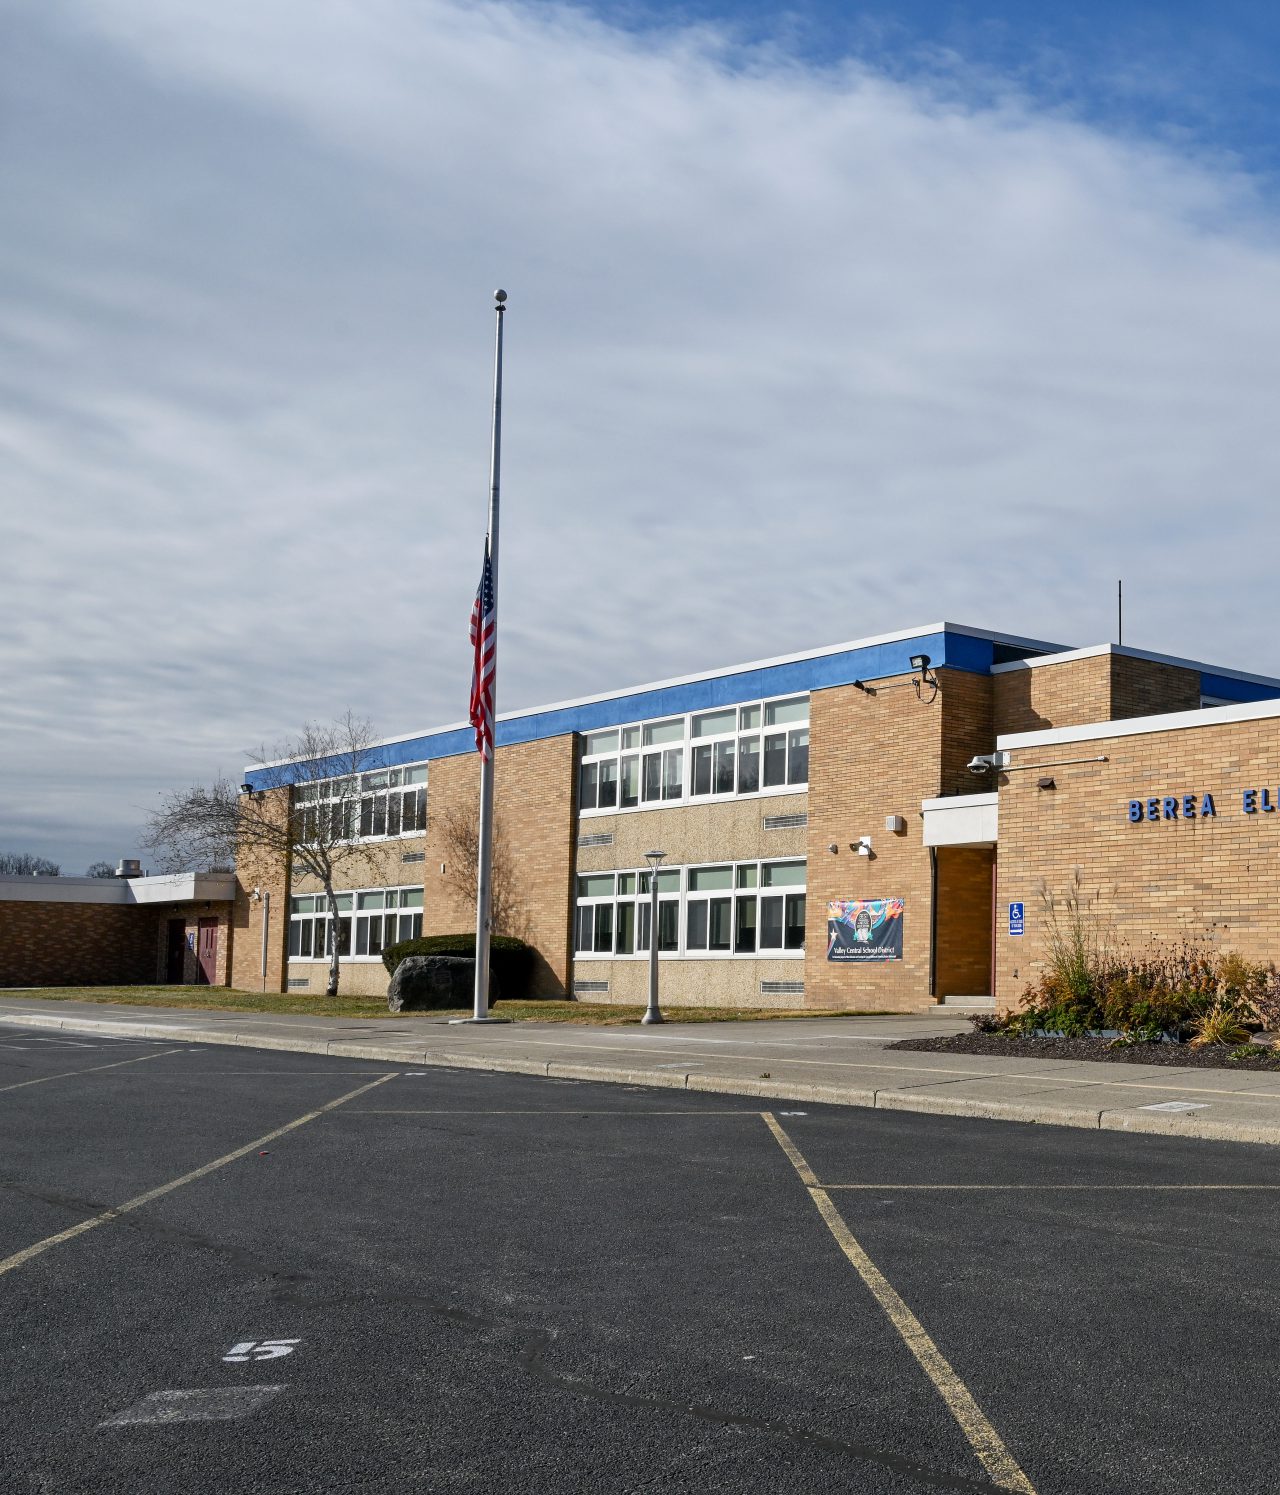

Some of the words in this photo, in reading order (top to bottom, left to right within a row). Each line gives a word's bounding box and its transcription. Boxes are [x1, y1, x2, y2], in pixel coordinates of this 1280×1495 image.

[1129, 793, 1215, 823] BEREA
[834, 947, 846, 955] Valley
[846, 946, 862, 954] Central
[862, 946, 878, 954] School
[878, 946, 894, 954] District
